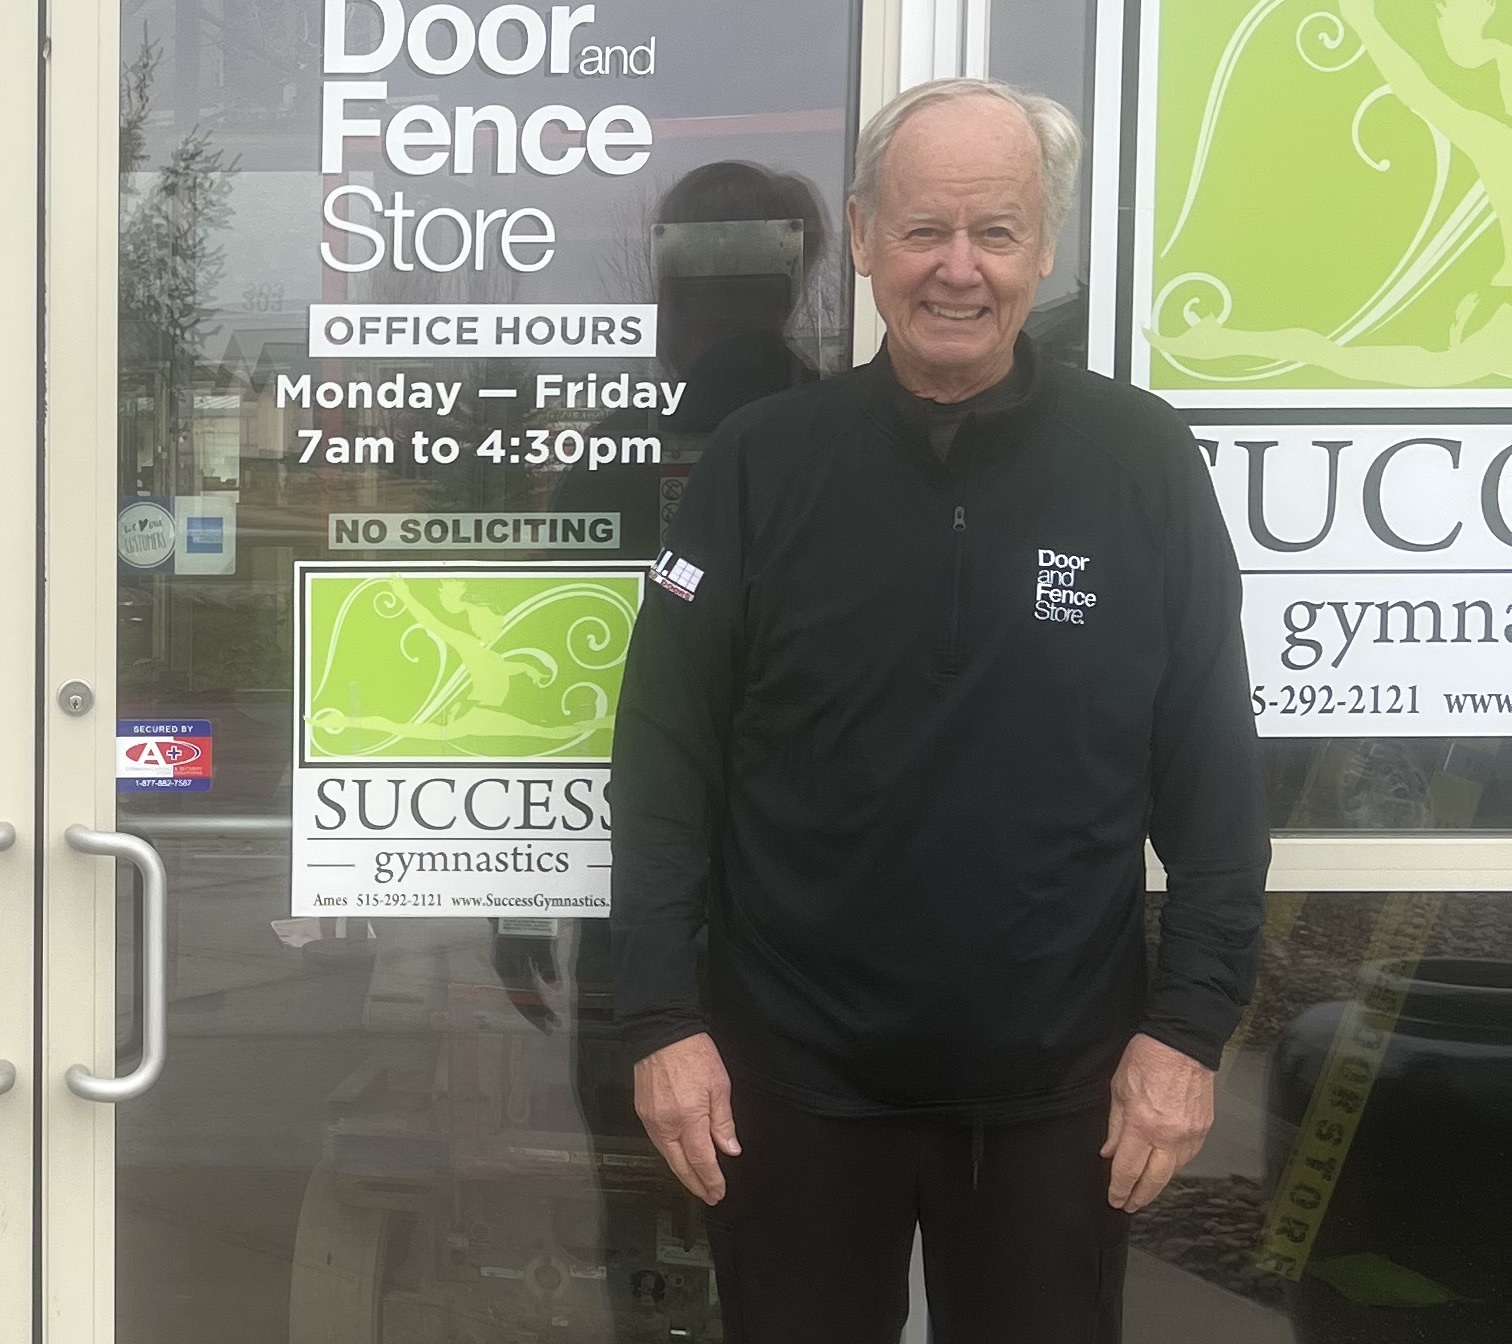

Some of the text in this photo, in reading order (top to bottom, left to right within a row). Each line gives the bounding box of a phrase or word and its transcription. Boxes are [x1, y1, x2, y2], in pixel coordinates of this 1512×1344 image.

[579, 37, 656, 76] and
[321, 81, 653, 176] Fence
[320, 185, 556, 273] Store
[324, 316, 643, 346] OFFICE HOURS
[275, 374, 462, 417] Monday
[536, 374, 687, 417] Friday
[298, 429, 662, 471] 7am to 4:30pm
[335, 518, 615, 544] NO SOLICITING
[1038, 549, 1091, 571] Door
[1037, 568, 1075, 587] and
[1036, 582, 1097, 608] Fence
[1281, 598, 1512, 671] gymn
[133, 725, 194, 734] SECURED BY
[374, 845, 570, 884] gymnastics
[313, 893, 348, 907] Ames
[356, 892, 443, 907] 515-292-2121
